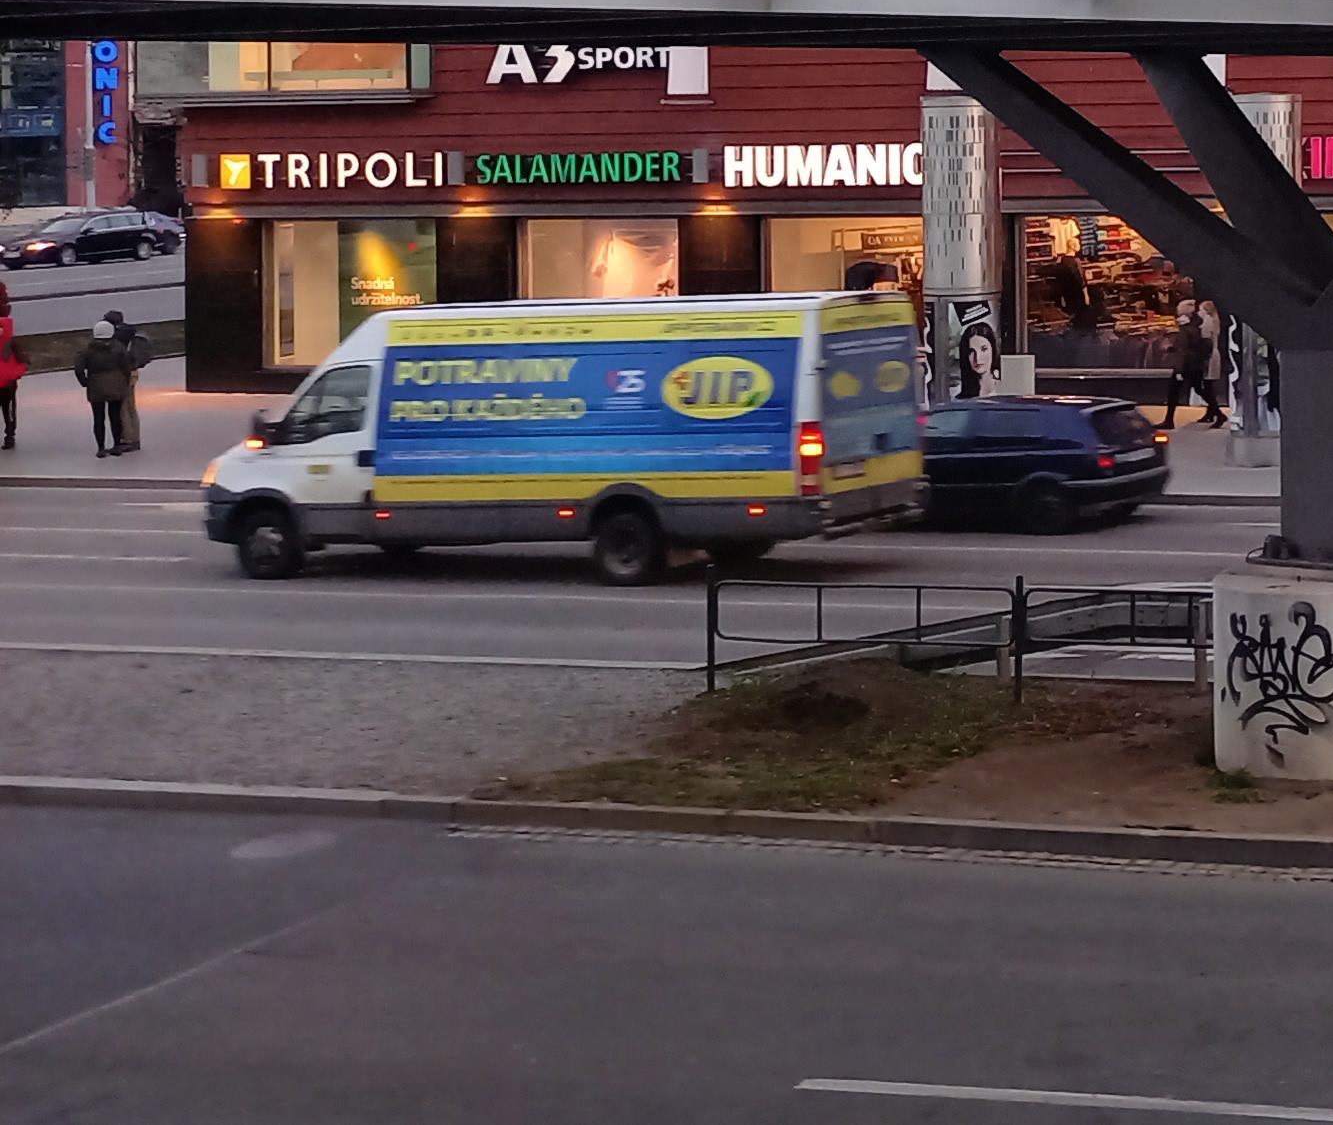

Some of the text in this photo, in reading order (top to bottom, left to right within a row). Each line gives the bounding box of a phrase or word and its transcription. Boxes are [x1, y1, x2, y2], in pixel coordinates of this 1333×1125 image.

[486, 44, 669, 84] A3 SPORT
[257, 151, 443, 189] TRIPOLI
[475, 151, 681, 184] SALAMANDER
[723, 143, 923, 188] HUMANIC
[392, 357, 578, 386] POTRAVINY
[680, 369, 756, 405] JIP
